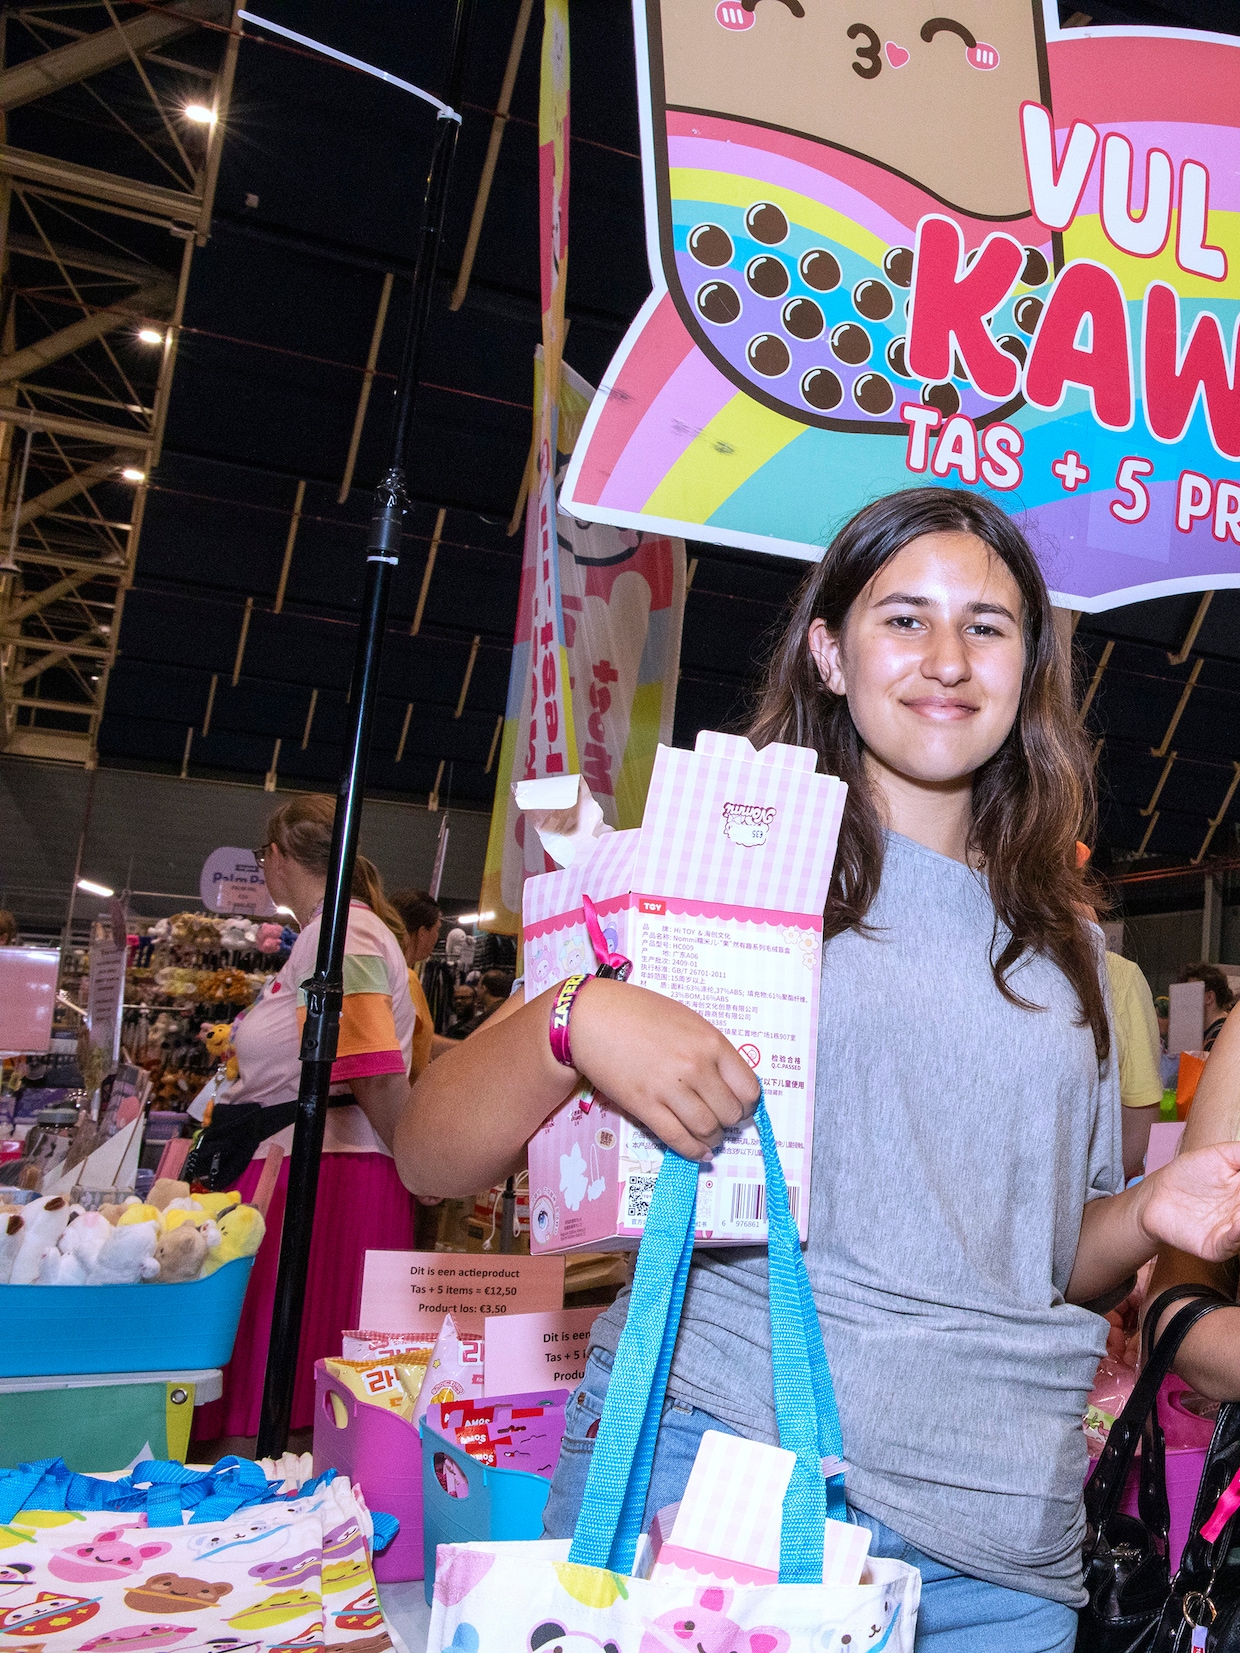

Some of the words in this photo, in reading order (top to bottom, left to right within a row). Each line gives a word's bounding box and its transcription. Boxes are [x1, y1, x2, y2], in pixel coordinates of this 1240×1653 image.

[1019, 100, 1227, 281] VUL
[900, 402, 1024, 491] TAS
[1052, 450, 1089, 491] +
[1110, 457, 1153, 524] 5
[672, 943, 695, 951] HC009
[672, 959, 698, 968] 2409-01
[671, 967, 688, 975] GB/T
[689, 969, 726, 978] 26701-2011
[762, 1077, 805, 1090] 以下儿童使用
[721, 1219, 726, 1227] 6
[735, 1220, 760, 1228] 976861
[410, 1266, 425, 1276] Dit
[427, 1266, 435, 1276] is
[458, 1268, 520, 1278] actieproduct
[410, 1285, 426, 1294] Tas
[437, 1285, 443, 1294] 5
[446, 1285, 473, 1295] items
[484, 1286, 517, 1296] €12,50
[418, 1303, 457, 1313] Product
[459, 1303, 478, 1313] los:
[543, 1333, 559, 1343] Dit
[561, 1332, 569, 1342] is
[545, 1353, 561, 1363] Tas
[574, 1351, 581, 1360] 5
[553, 1370, 584, 1382] Produ
[460, 1434, 487, 1445] AMOS
